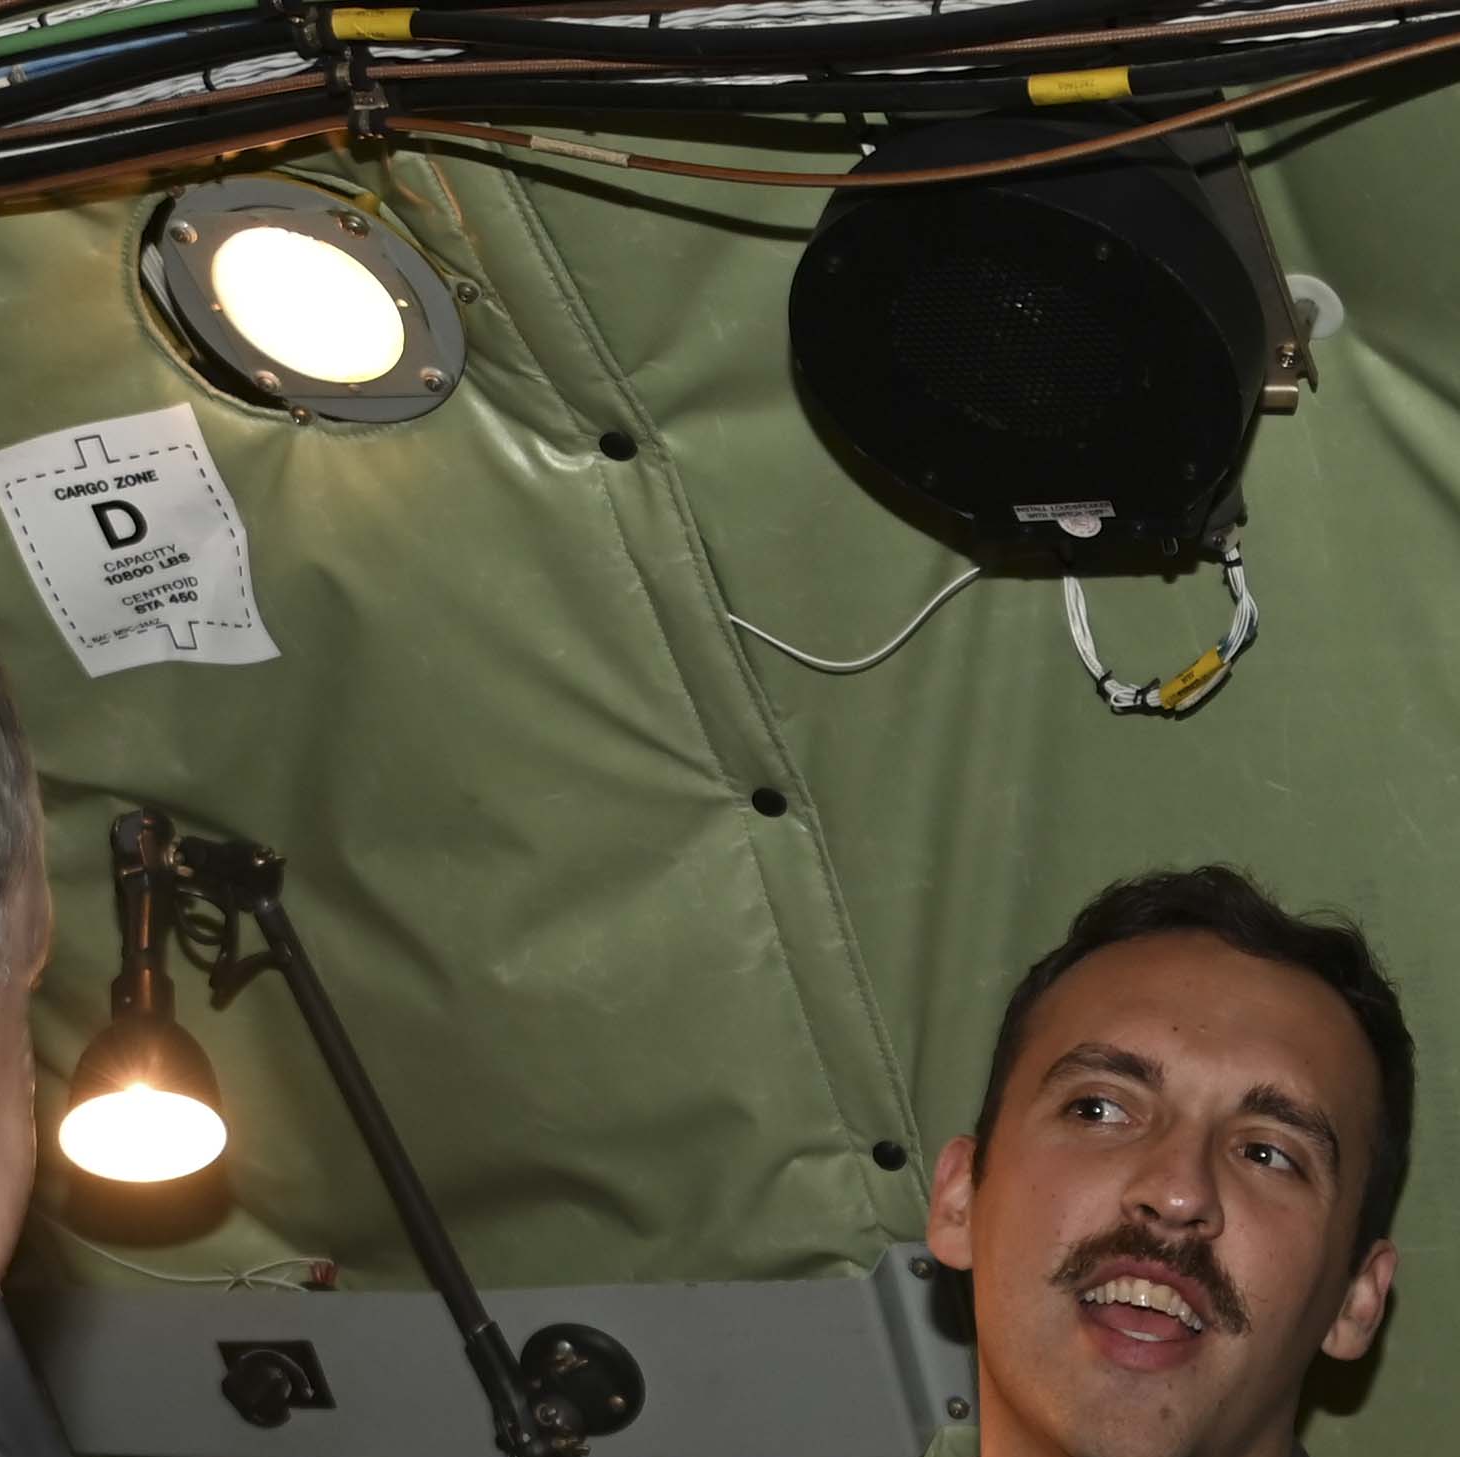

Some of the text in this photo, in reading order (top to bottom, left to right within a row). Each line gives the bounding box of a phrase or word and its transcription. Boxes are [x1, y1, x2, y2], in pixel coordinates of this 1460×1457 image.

[54, 469, 159, 501] CARGO ZONE
[91, 499, 148, 550] D
[103, 544, 176, 573] CAPACITY
[104, 552, 191, 586] 10800 LBS
[121, 576, 198, 606] CENTROID
[134, 590, 198, 615] STA 450
